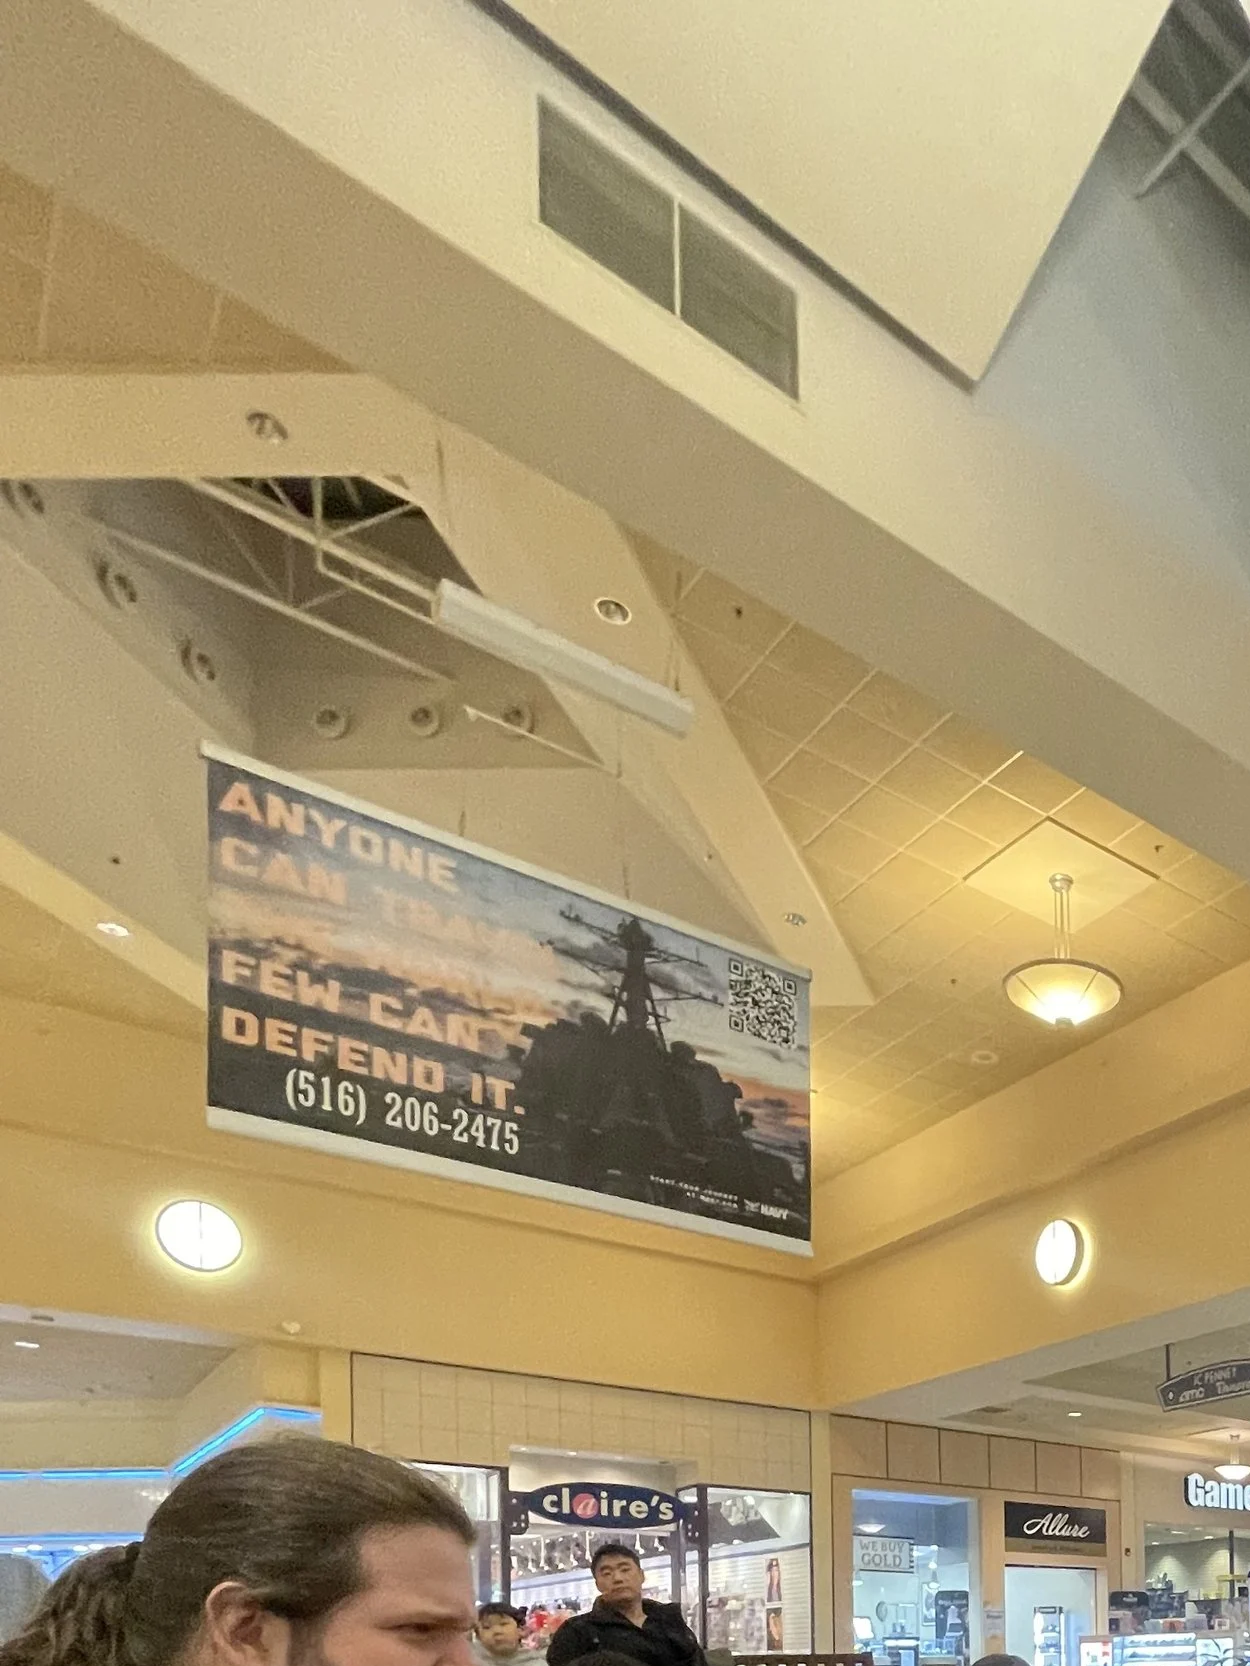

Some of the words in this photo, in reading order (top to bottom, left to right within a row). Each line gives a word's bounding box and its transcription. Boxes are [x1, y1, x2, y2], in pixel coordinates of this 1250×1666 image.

[218, 782, 460, 892] ANYONE
[221, 837, 347, 905] CAN
[222, 949, 341, 1013] FEW
[369, 993, 479, 1052] CAN
[222, 1006, 445, 1093] DEFEND
[471, 1072, 526, 1115] IT.
[285, 1068, 367, 1126] (516)
[385, 1092, 520, 1155] 206-2475
[542, 1487, 674, 1520] claire's
[1023, 1513, 1090, 1538] Allure
[860, 1541, 878, 1552] WE
[881, 1541, 905, 1553] BUY
[861, 1552, 903, 1567] GOLD
